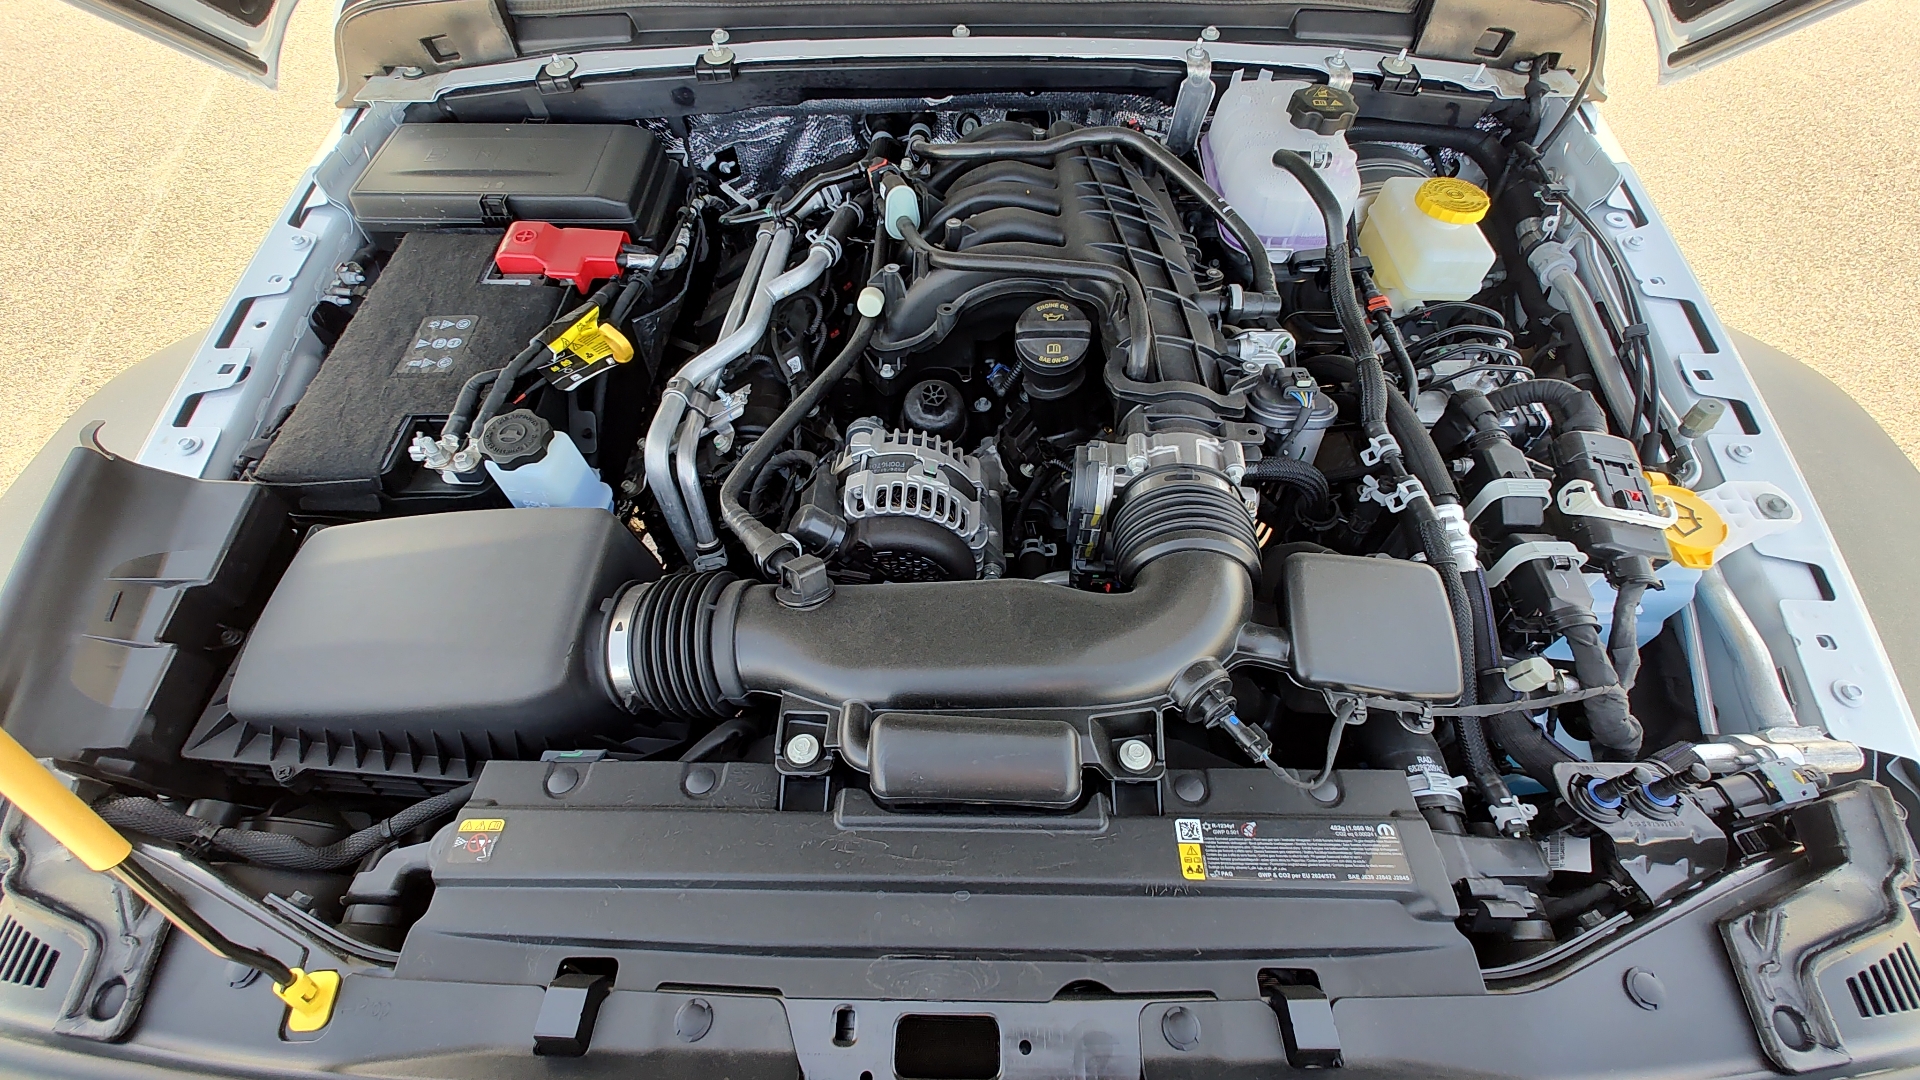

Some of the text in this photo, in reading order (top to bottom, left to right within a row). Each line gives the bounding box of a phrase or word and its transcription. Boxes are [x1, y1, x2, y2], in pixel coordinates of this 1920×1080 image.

[1036, 303, 1070, 311] ENGINE OIL
[1038, 355, 1069, 363] SAE 0W-20
